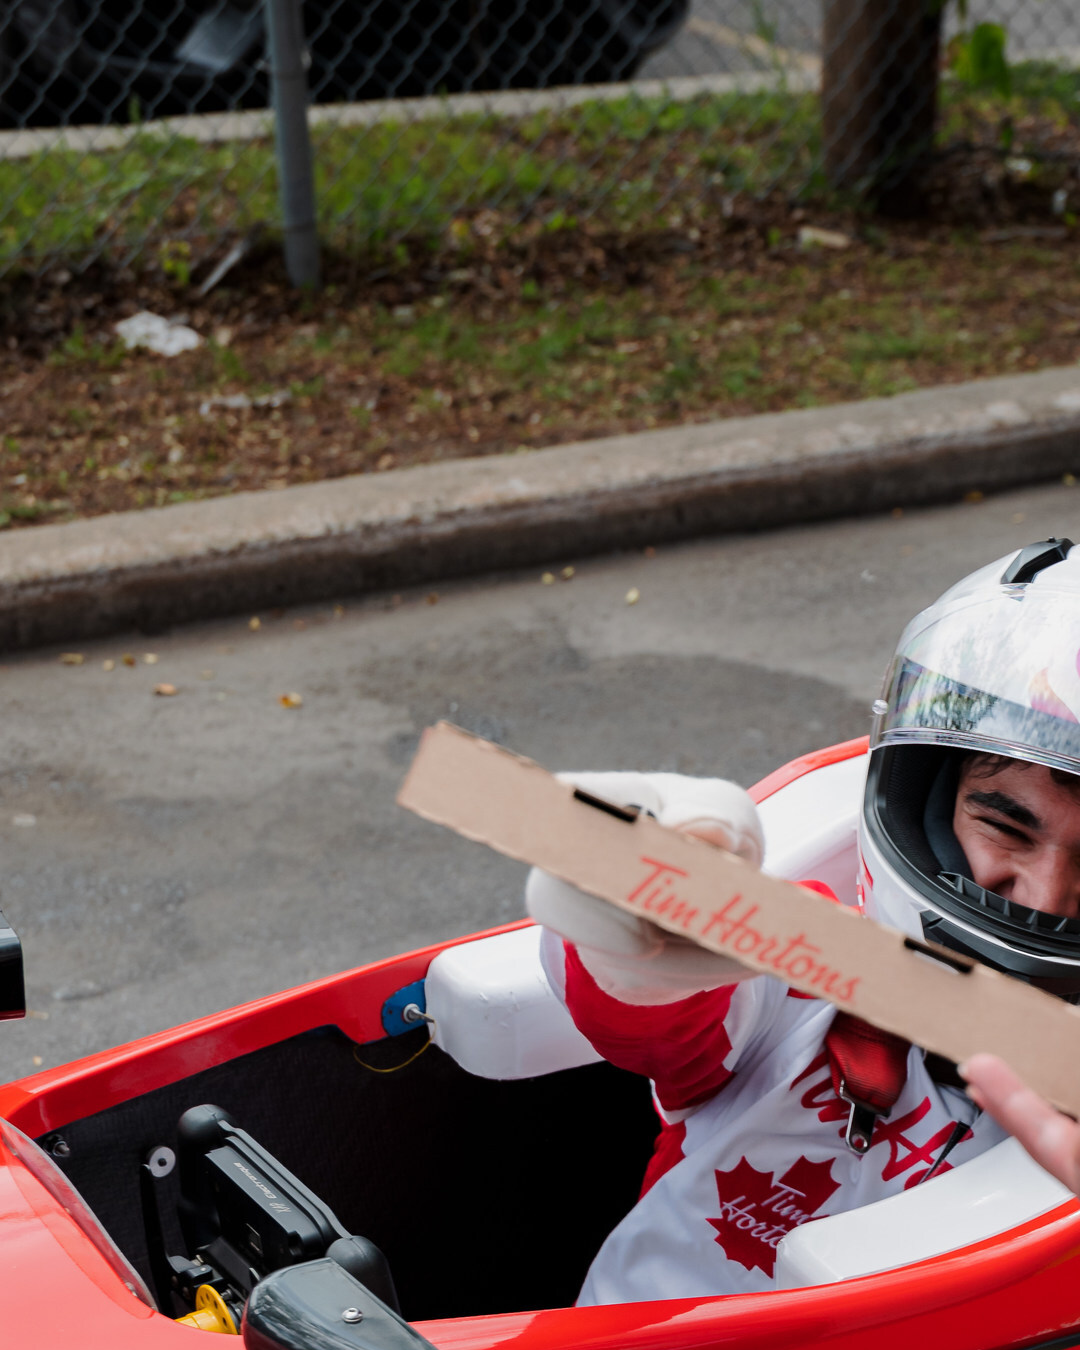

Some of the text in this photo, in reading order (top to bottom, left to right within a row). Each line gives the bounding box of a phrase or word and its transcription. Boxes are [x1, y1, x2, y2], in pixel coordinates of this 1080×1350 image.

[627, 856, 861, 1003] Tim Hortons
[761, 1180, 810, 1225] Tim
